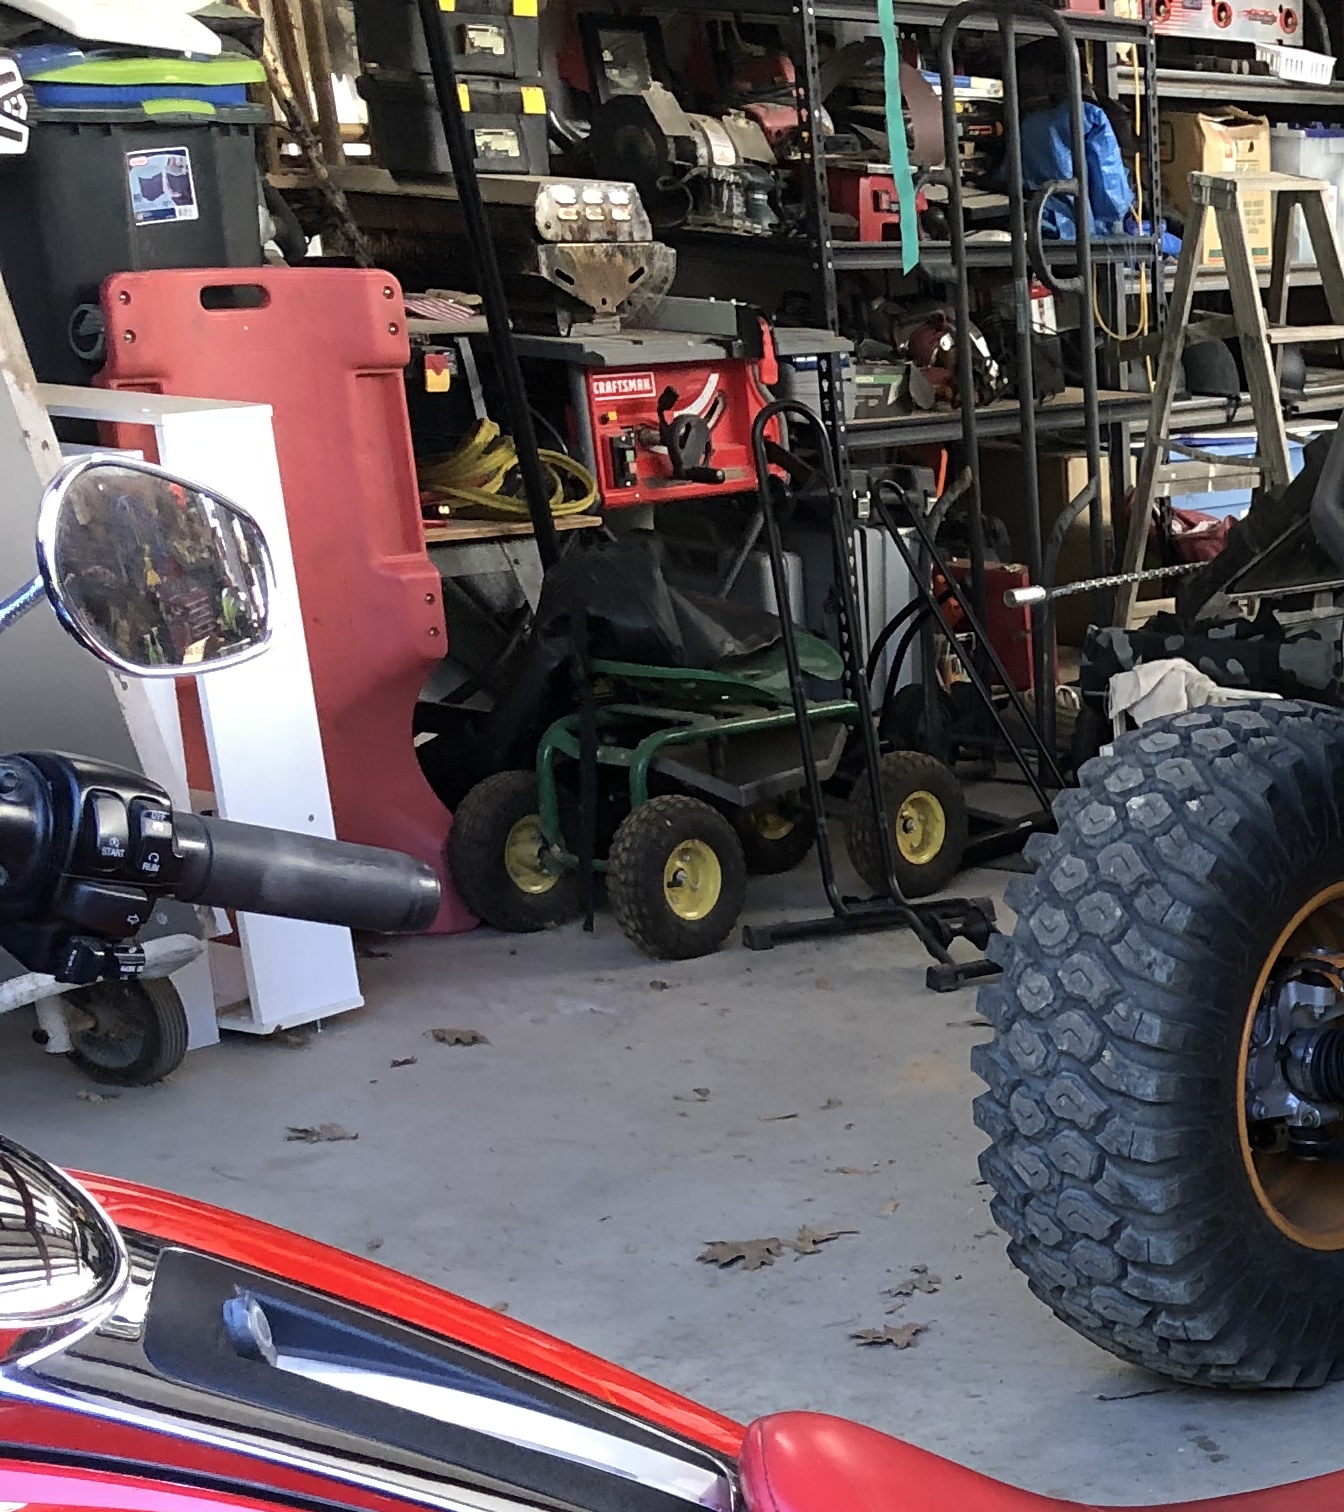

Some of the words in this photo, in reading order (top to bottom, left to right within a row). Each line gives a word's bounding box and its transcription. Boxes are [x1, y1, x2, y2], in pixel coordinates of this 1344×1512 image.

[593, 378, 652, 395] CRAFTSMAN
[101, 846, 125, 858] START
[141, 861, 161, 872] RUN
